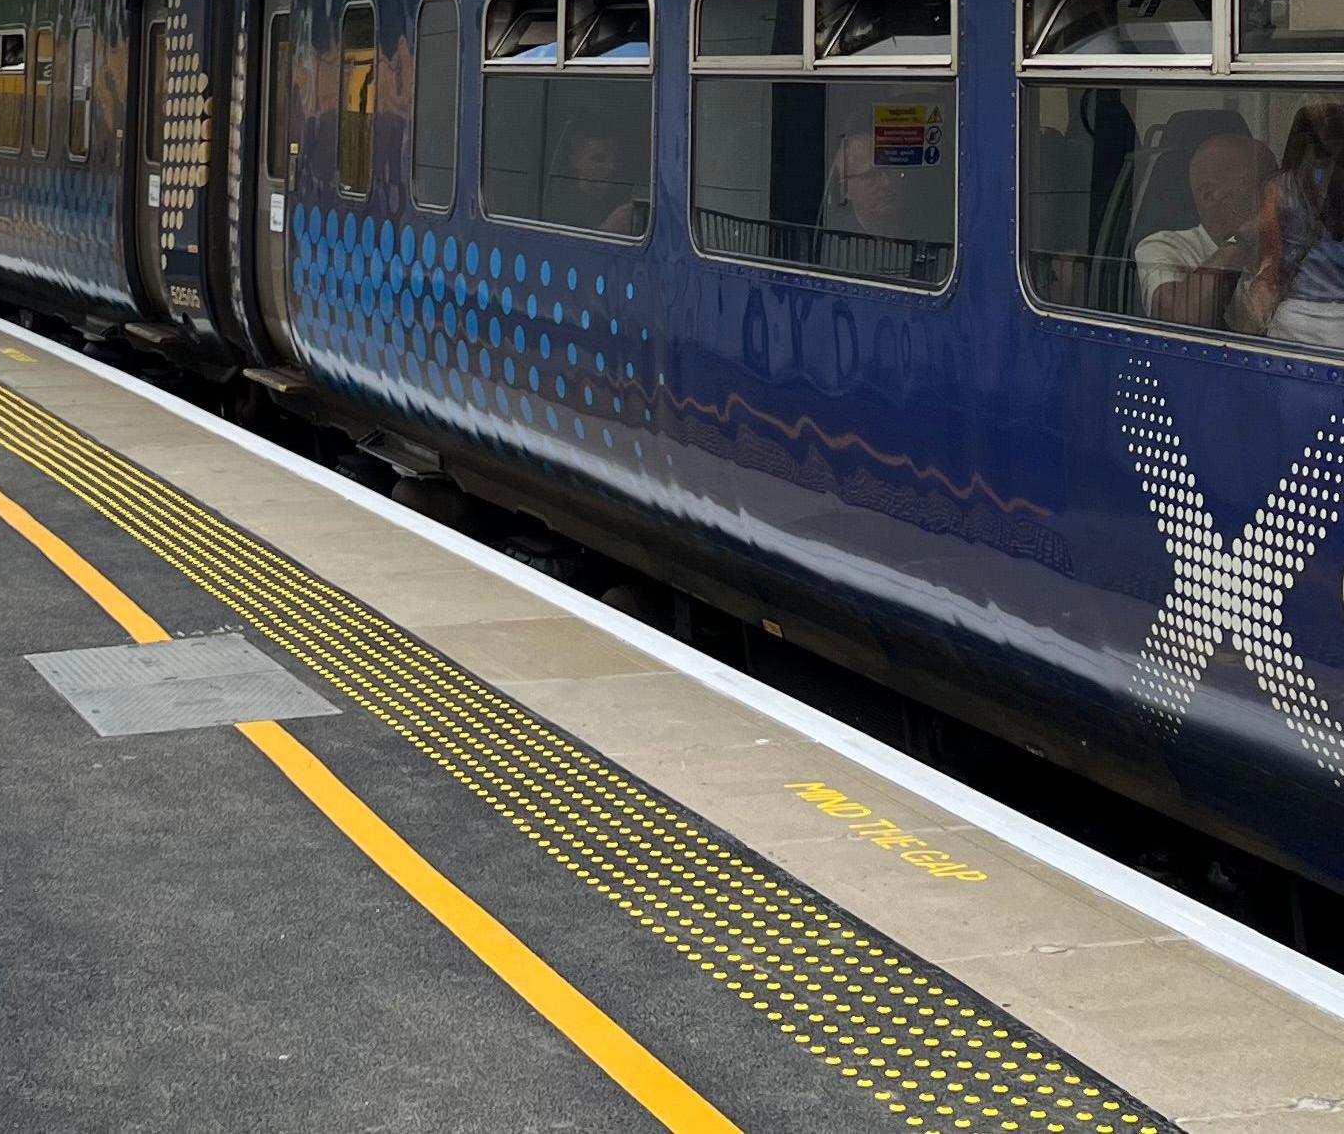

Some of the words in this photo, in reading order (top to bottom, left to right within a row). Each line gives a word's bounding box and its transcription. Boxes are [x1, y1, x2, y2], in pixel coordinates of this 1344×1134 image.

[783, 782, 872, 818] MIND
[847, 818, 928, 850] THE
[900, 849, 988, 881] GAP
